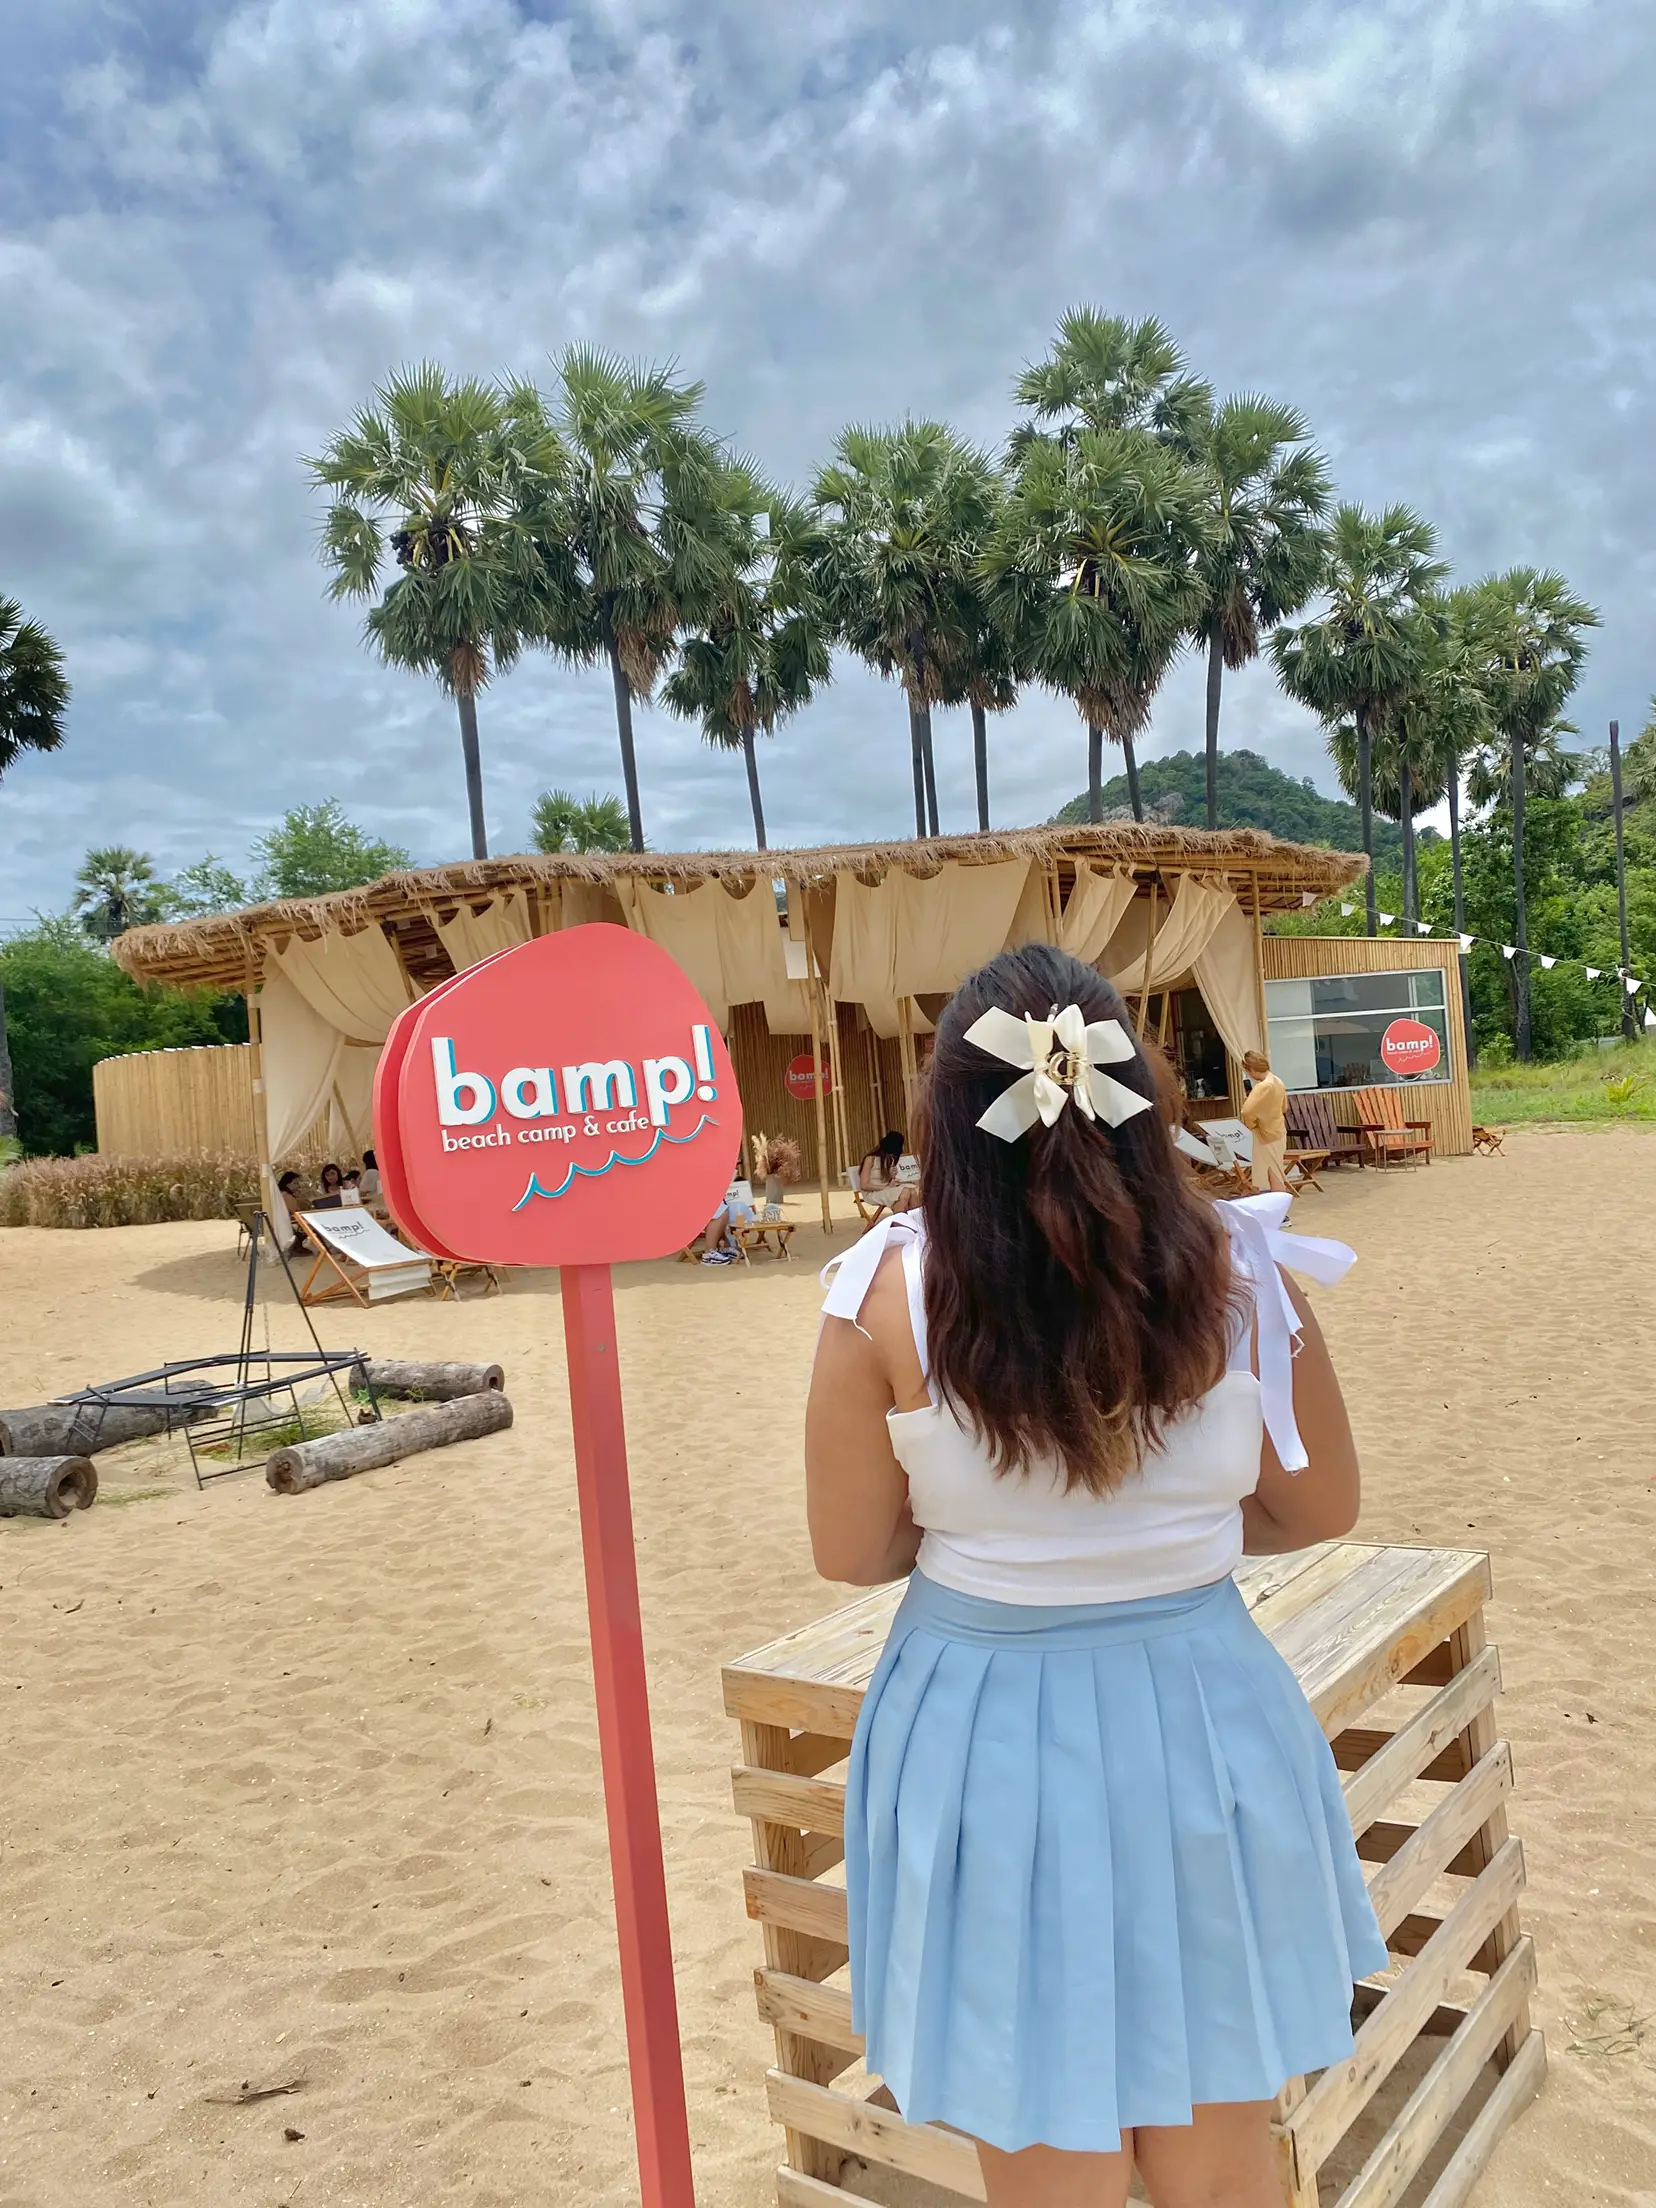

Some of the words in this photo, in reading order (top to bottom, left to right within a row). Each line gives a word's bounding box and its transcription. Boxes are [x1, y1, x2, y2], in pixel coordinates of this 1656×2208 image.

[1386, 1034, 1433, 1052] bamp!
[431, 1024, 717, 1127] bamp!
[441, 1123, 511, 1152] beach
[517, 1124, 576, 1144] camp
[583, 1115, 600, 1136] &
[605, 1110, 650, 1134] cafe
[320, 1221, 364, 1232] bamp!
